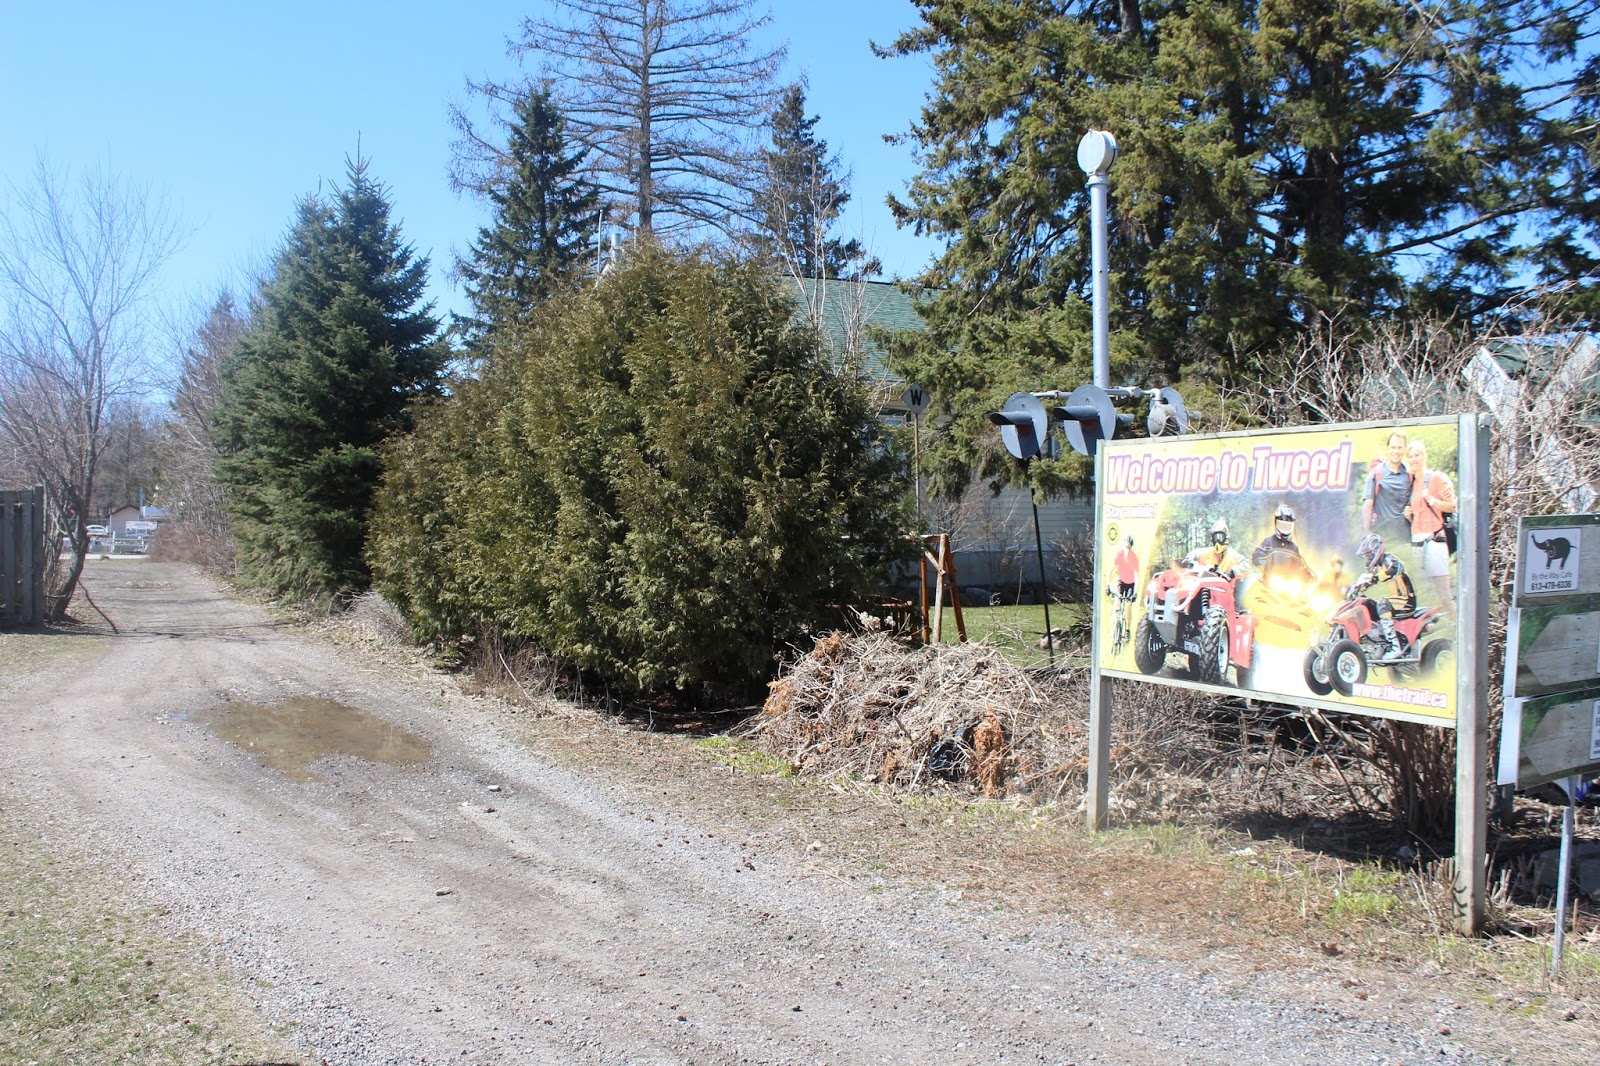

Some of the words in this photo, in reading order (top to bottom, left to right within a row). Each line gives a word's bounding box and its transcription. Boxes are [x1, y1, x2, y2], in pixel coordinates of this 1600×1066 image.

[910, 389, 922, 406] W
[1106, 453, 1216, 494] Welcome
[1219, 451, 1248, 492] to
[1252, 441, 1352, 491] Tweed
[1106, 503, 1121, 520] Stay
[1123, 505, 1130, 518] a
[1130, 503, 1157, 518] while!
[1531, 573, 1538, 581] By
[1539, 572, 1548, 580] the
[1352, 683, 1448, 709] www.thetrail.ca
